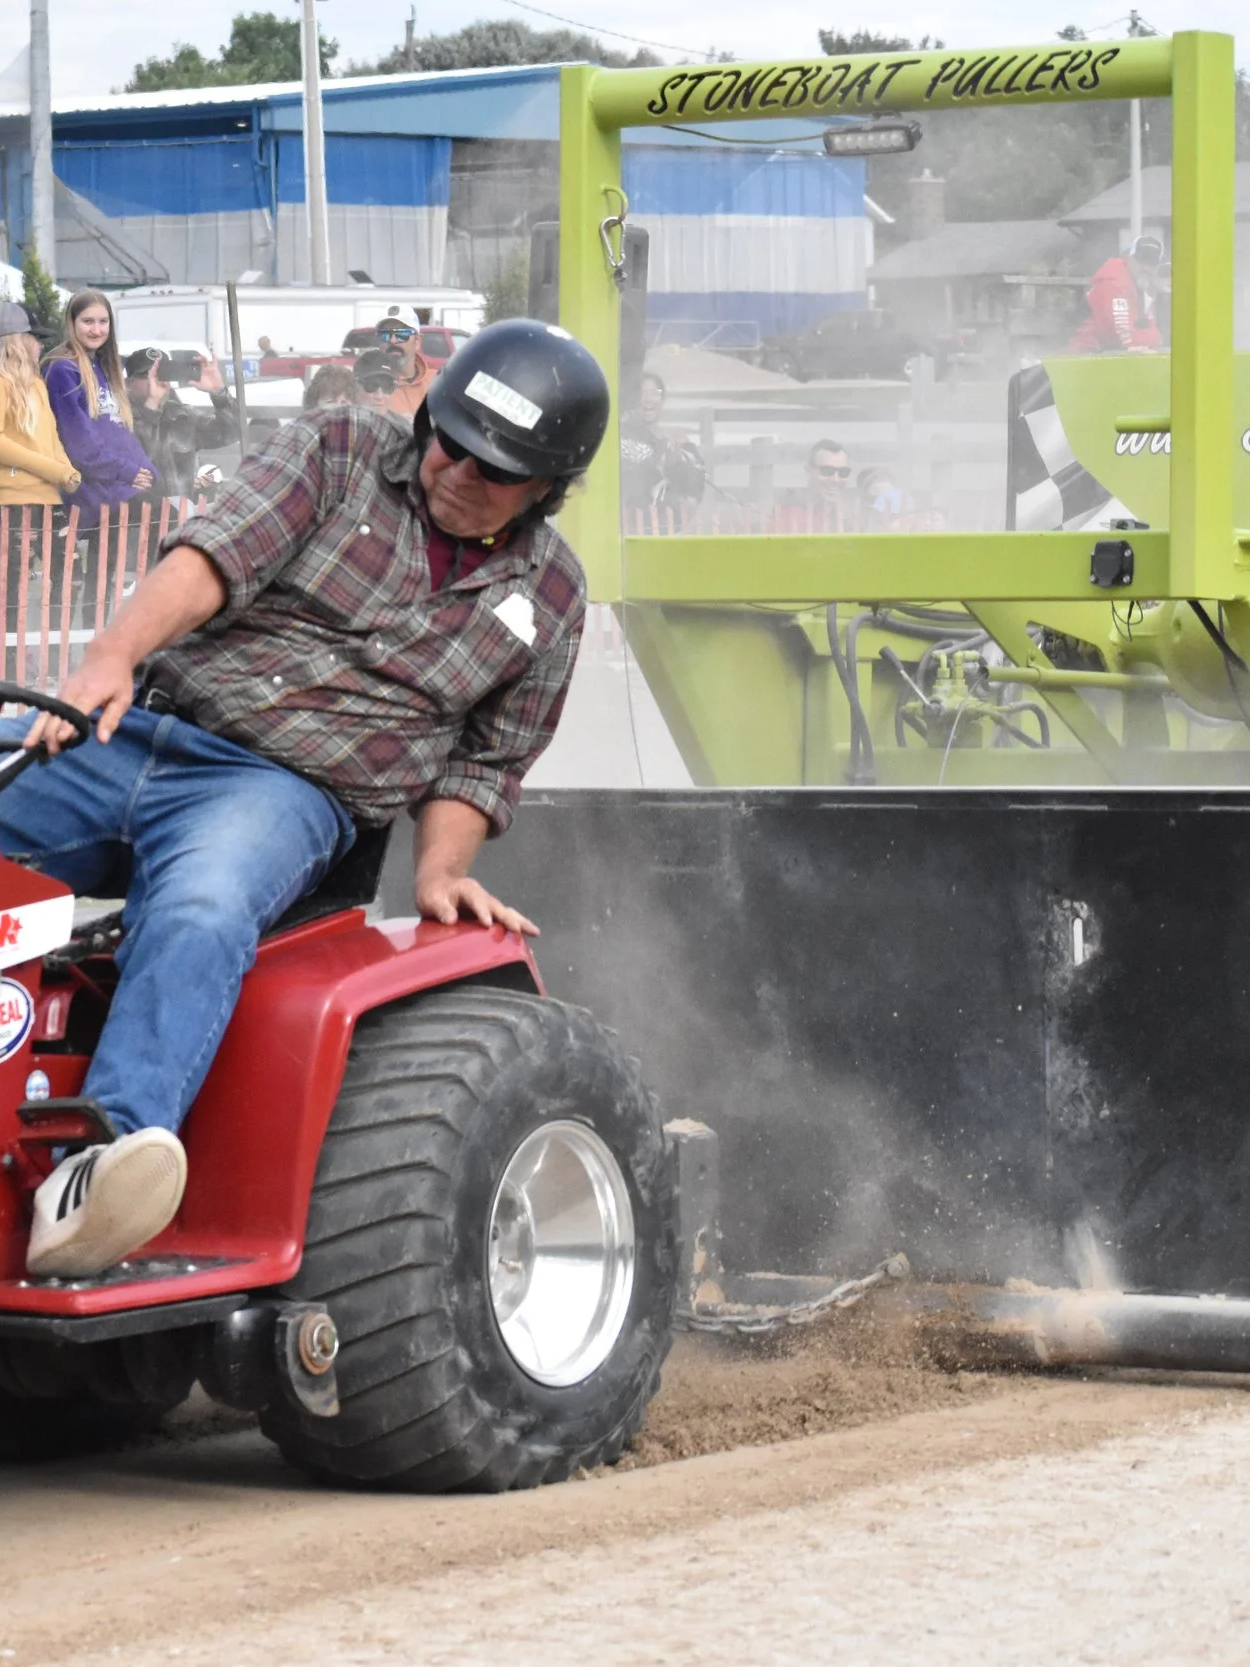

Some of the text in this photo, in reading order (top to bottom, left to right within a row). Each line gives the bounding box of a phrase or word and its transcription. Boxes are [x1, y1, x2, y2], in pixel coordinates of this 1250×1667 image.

[648, 47, 1120, 115] STONEBOAT PULLERS
[472, 374, 540, 420] PATIENT
